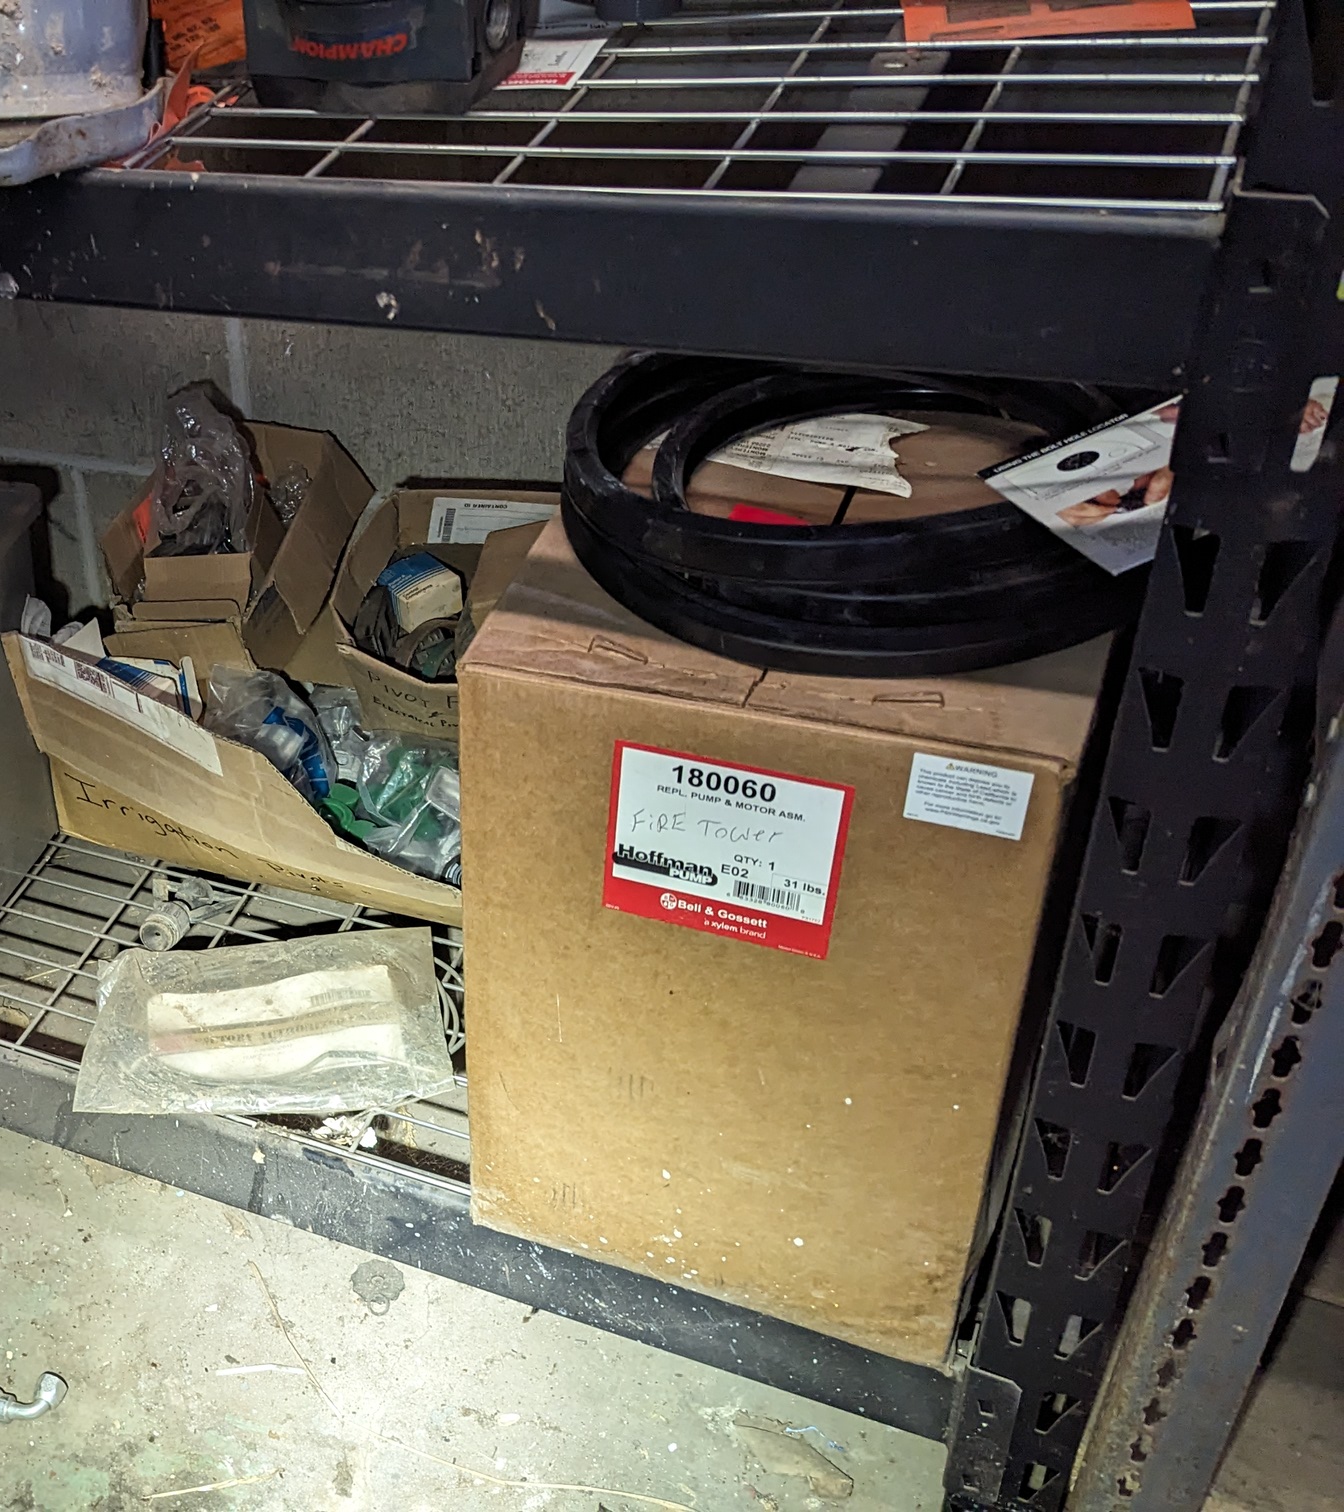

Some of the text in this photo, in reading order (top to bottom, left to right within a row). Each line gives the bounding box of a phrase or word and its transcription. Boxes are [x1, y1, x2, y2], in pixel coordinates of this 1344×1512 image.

[954, 764, 997, 778] WARNING
[672, 765, 777, 802] 180060
[657, 785, 687, 798] REPL.
[691, 792, 721, 804] PUMP
[735, 802, 776, 816] MOTOR
[778, 810, 806, 823] ASM.
[64, 772, 240, 860] Irrigation
[617, 843, 714, 877] Hoffman
[734, 854, 775, 871] QTY: 1
[669, 868, 714, 886] PUMP
[720, 864, 749, 879] E02
[784, 878, 826, 896] 31 lbs.
[678, 899, 767, 929] Bell & Gossett
[711, 919, 738, 933] xylem
[739, 925, 766, 939] brand
